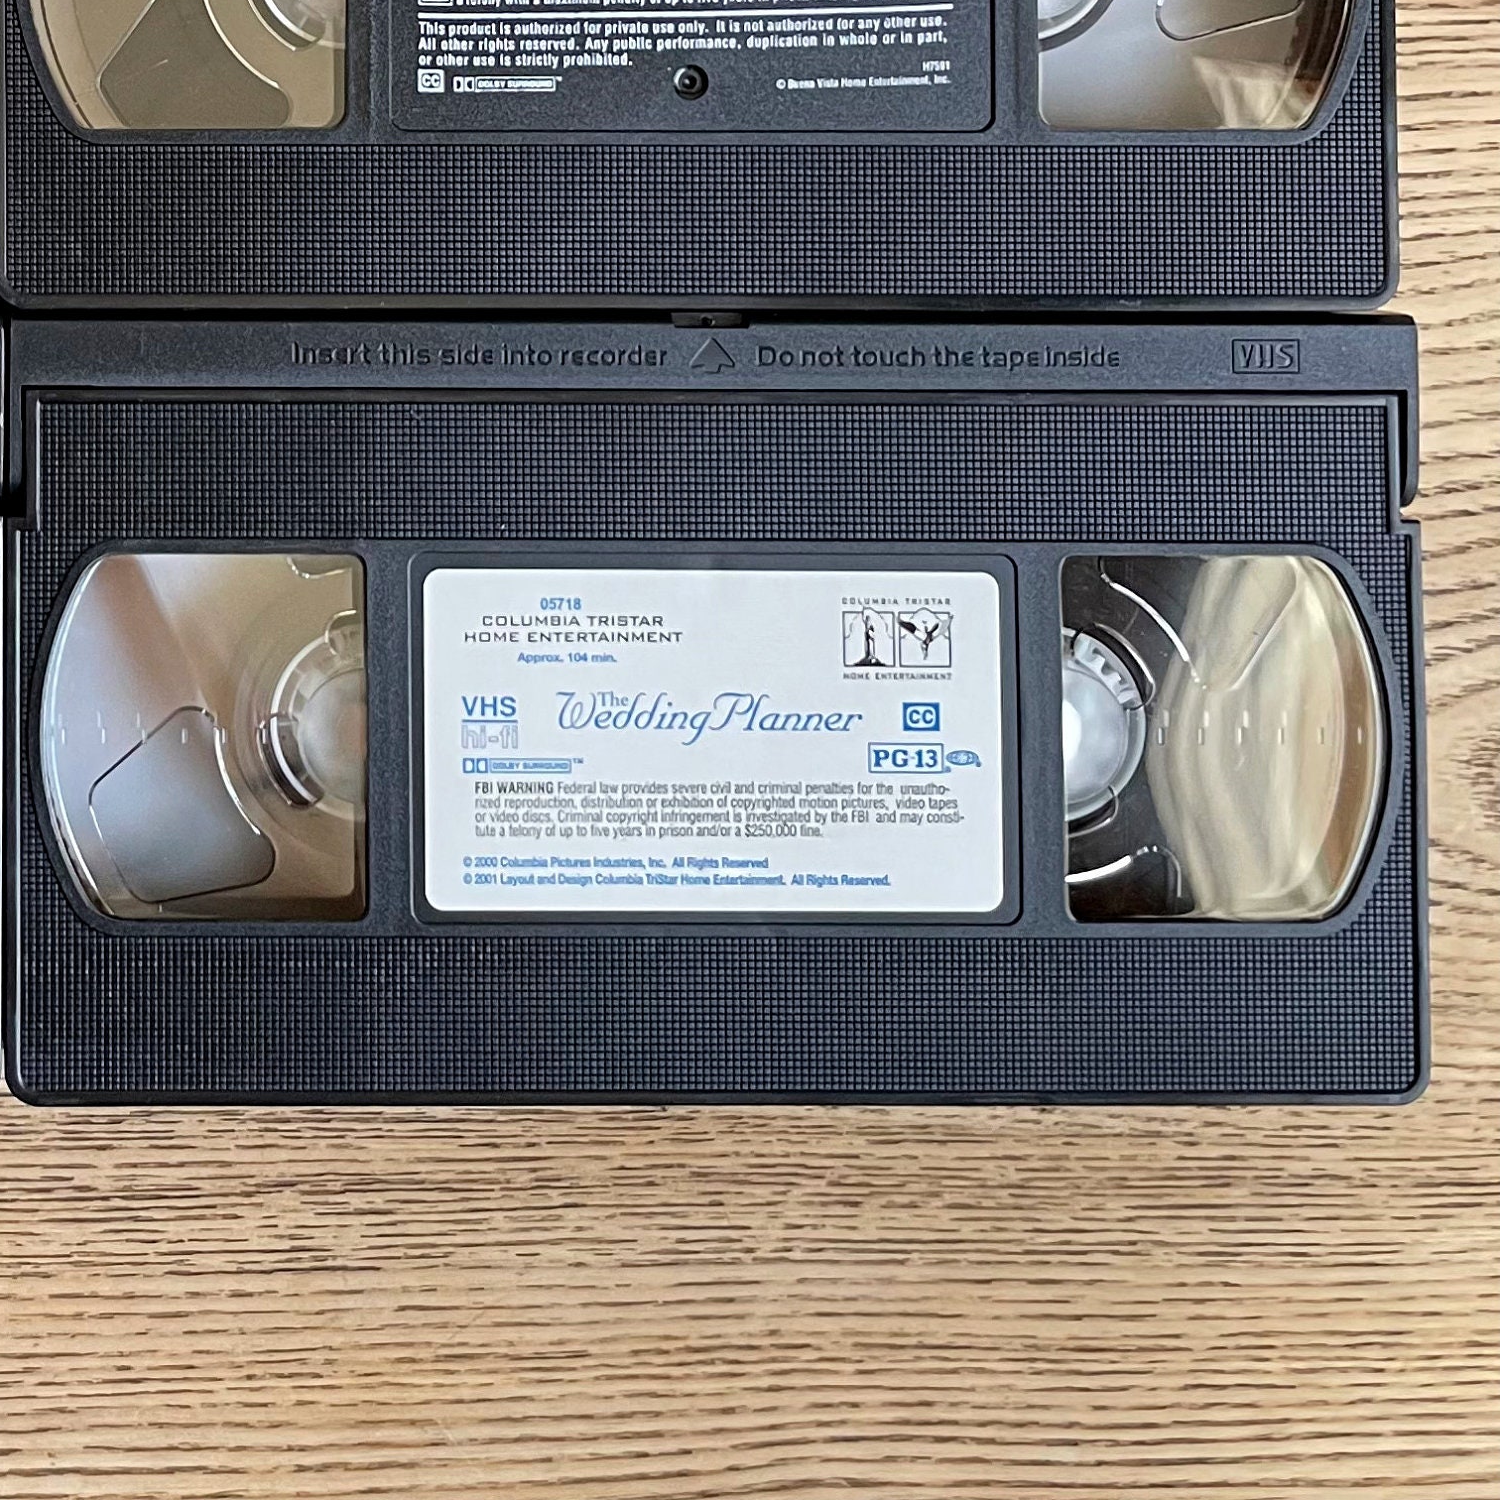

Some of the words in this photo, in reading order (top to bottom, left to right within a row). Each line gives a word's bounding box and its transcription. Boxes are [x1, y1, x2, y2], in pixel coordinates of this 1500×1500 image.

[417, 55, 434, 67] or
[435, 53, 469, 67] other
[472, 54, 495, 66] use
[499, 53, 511, 66] is
[514, 52, 559, 69] strictly
[562, 51, 633, 68] prohibited.
[420, 73, 441, 88] CC
[539, 597, 581, 610] 05718
[841, 597, 899, 605] COLUMBIA
[905, 597, 951, 605] TRISTAR
[482, 615, 580, 626] COLUMBIA
[586, 615, 663, 627] TRISTAR
[464, 631, 519, 642] HOME
[527, 631, 683, 643] ENTERTAINMENT
[516, 652, 564, 664] Approx.
[567, 652, 588, 662] 104
[590, 652, 617, 663] min.
[461, 695, 516, 717] VHS
[596, 691, 629, 707] The
[555, 690, 712, 746] Wedding
[708, 691, 864, 732] Planner
[907, 708, 935, 726] CC
[461, 725, 518, 749] hi-fi
[872, 748, 938, 768] PG-13
